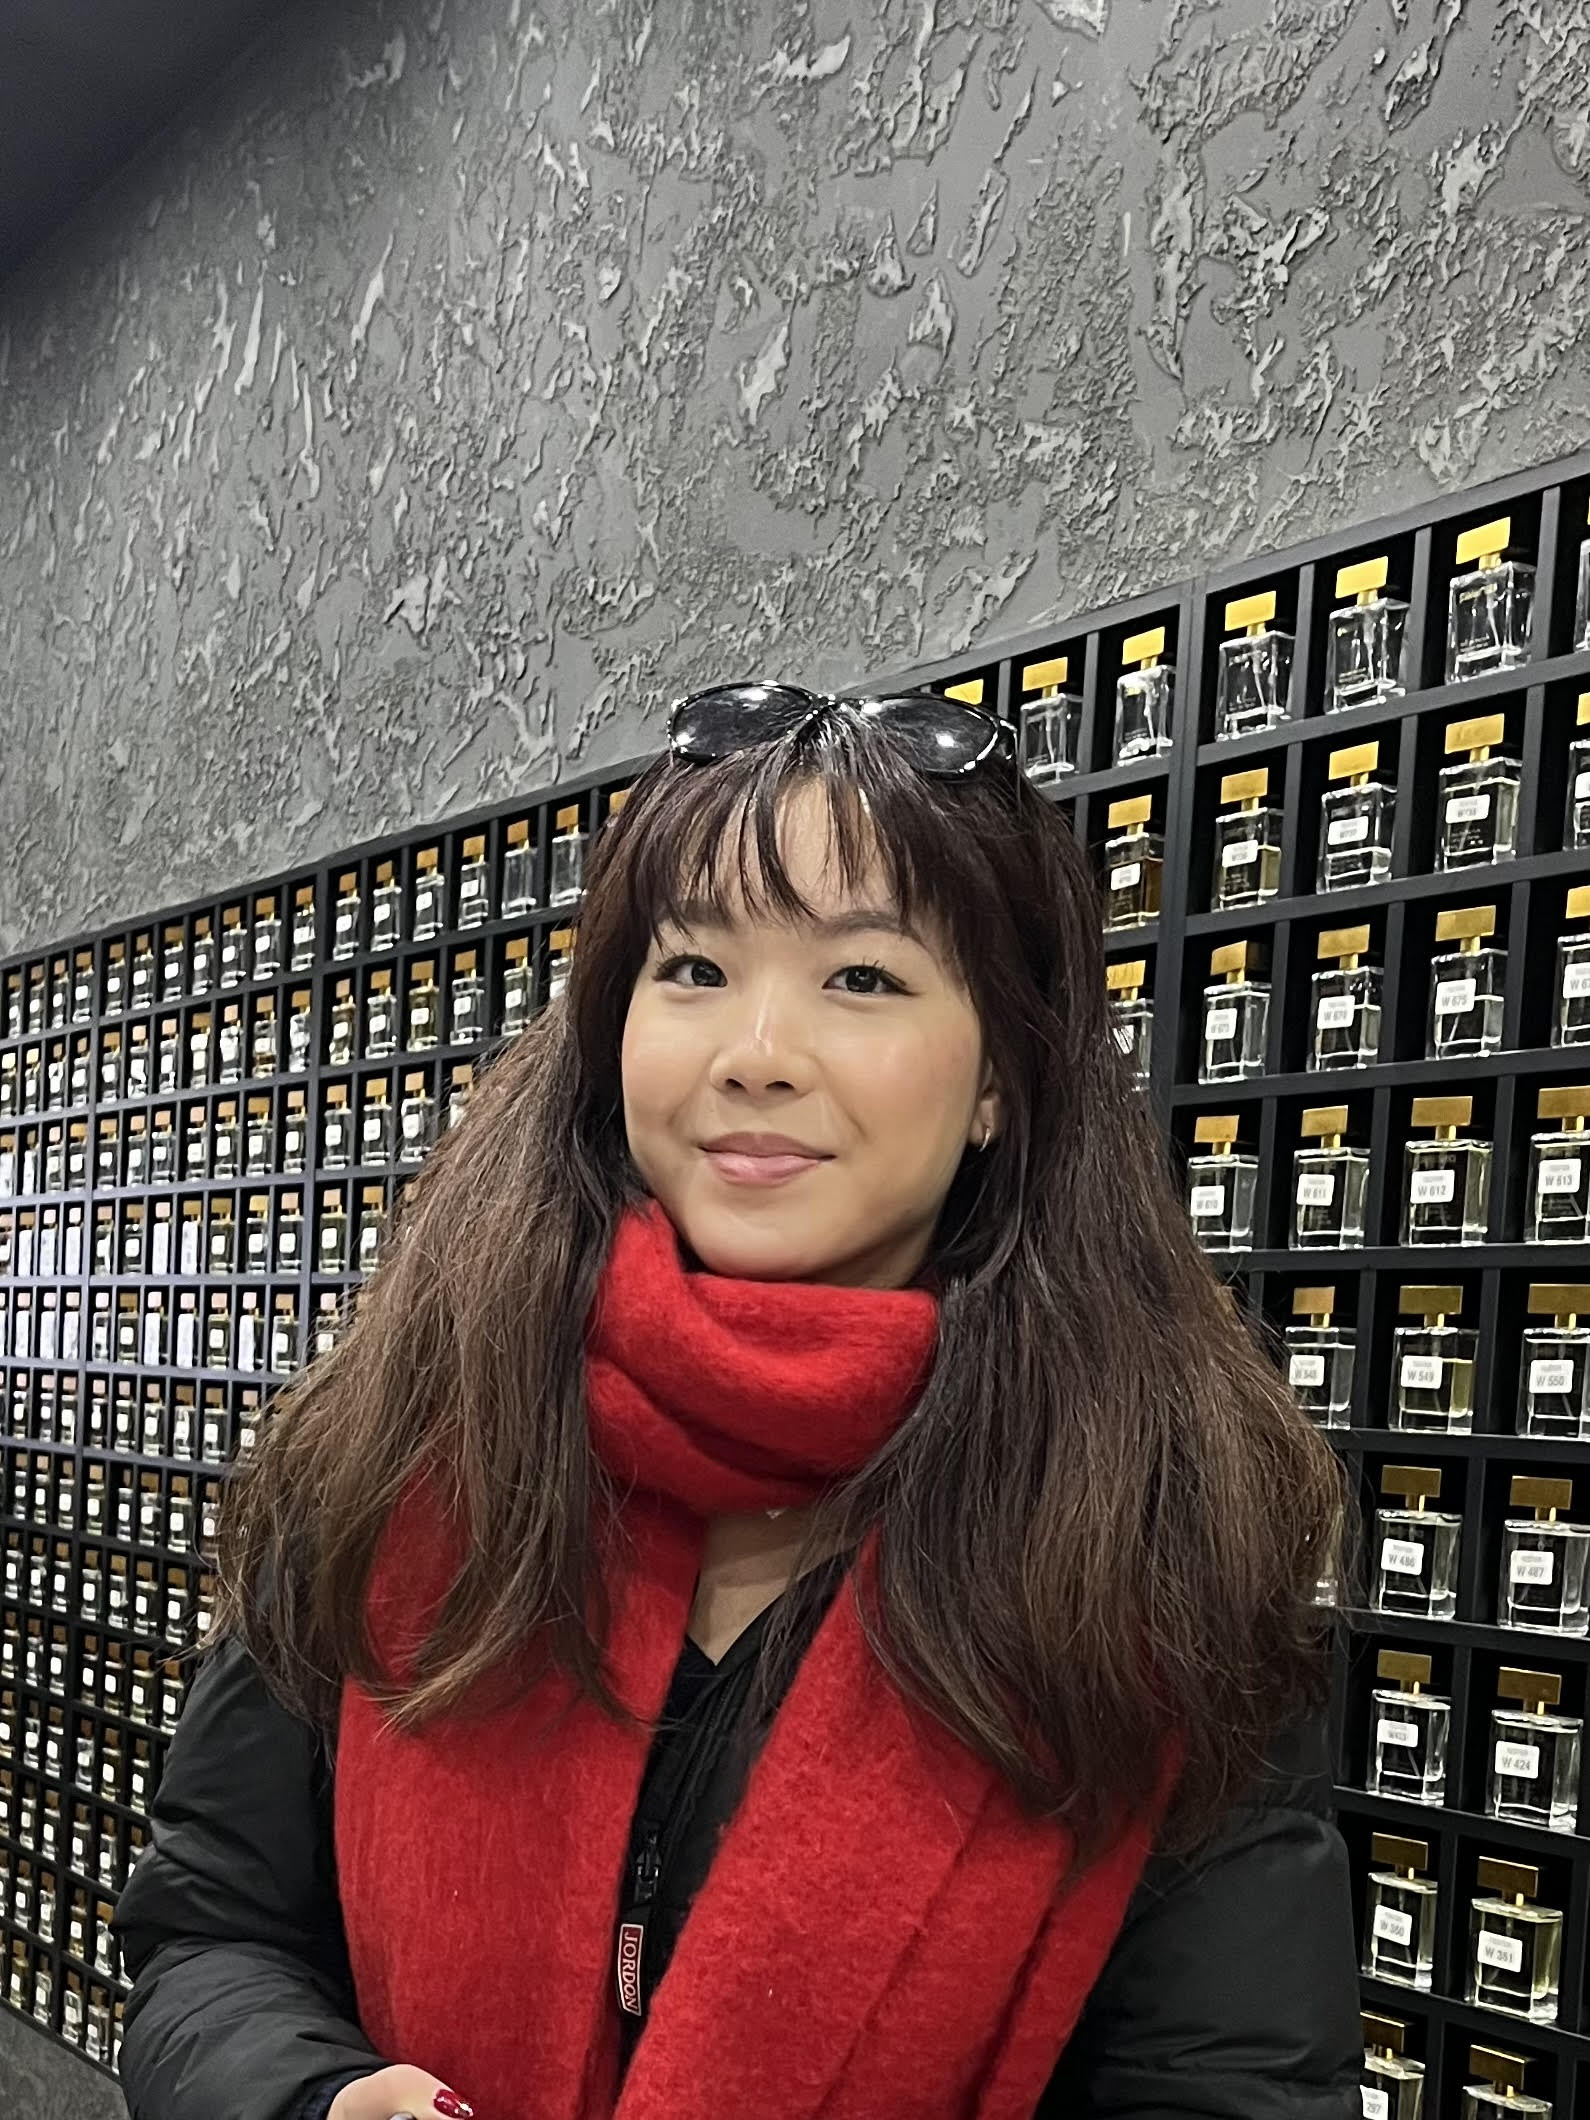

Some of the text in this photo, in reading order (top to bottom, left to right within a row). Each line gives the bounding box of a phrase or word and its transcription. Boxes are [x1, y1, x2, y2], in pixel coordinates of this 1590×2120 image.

[1545, 1175, 1554, 1187] W
[1303, 1187, 1312, 1199] W
[1417, 1184, 1446, 1197] W 612
[1407, 1370, 1417, 1381] W
[1536, 1375, 1565, 1387] W 550
[1388, 1554, 1397, 1565] W
[1516, 1565, 1544, 1578] W 487
[1502, 1756, 1531, 1771] W 424
[1485, 1946, 1495, 1958] W
[622, 1931, 638, 2010] JORDON
